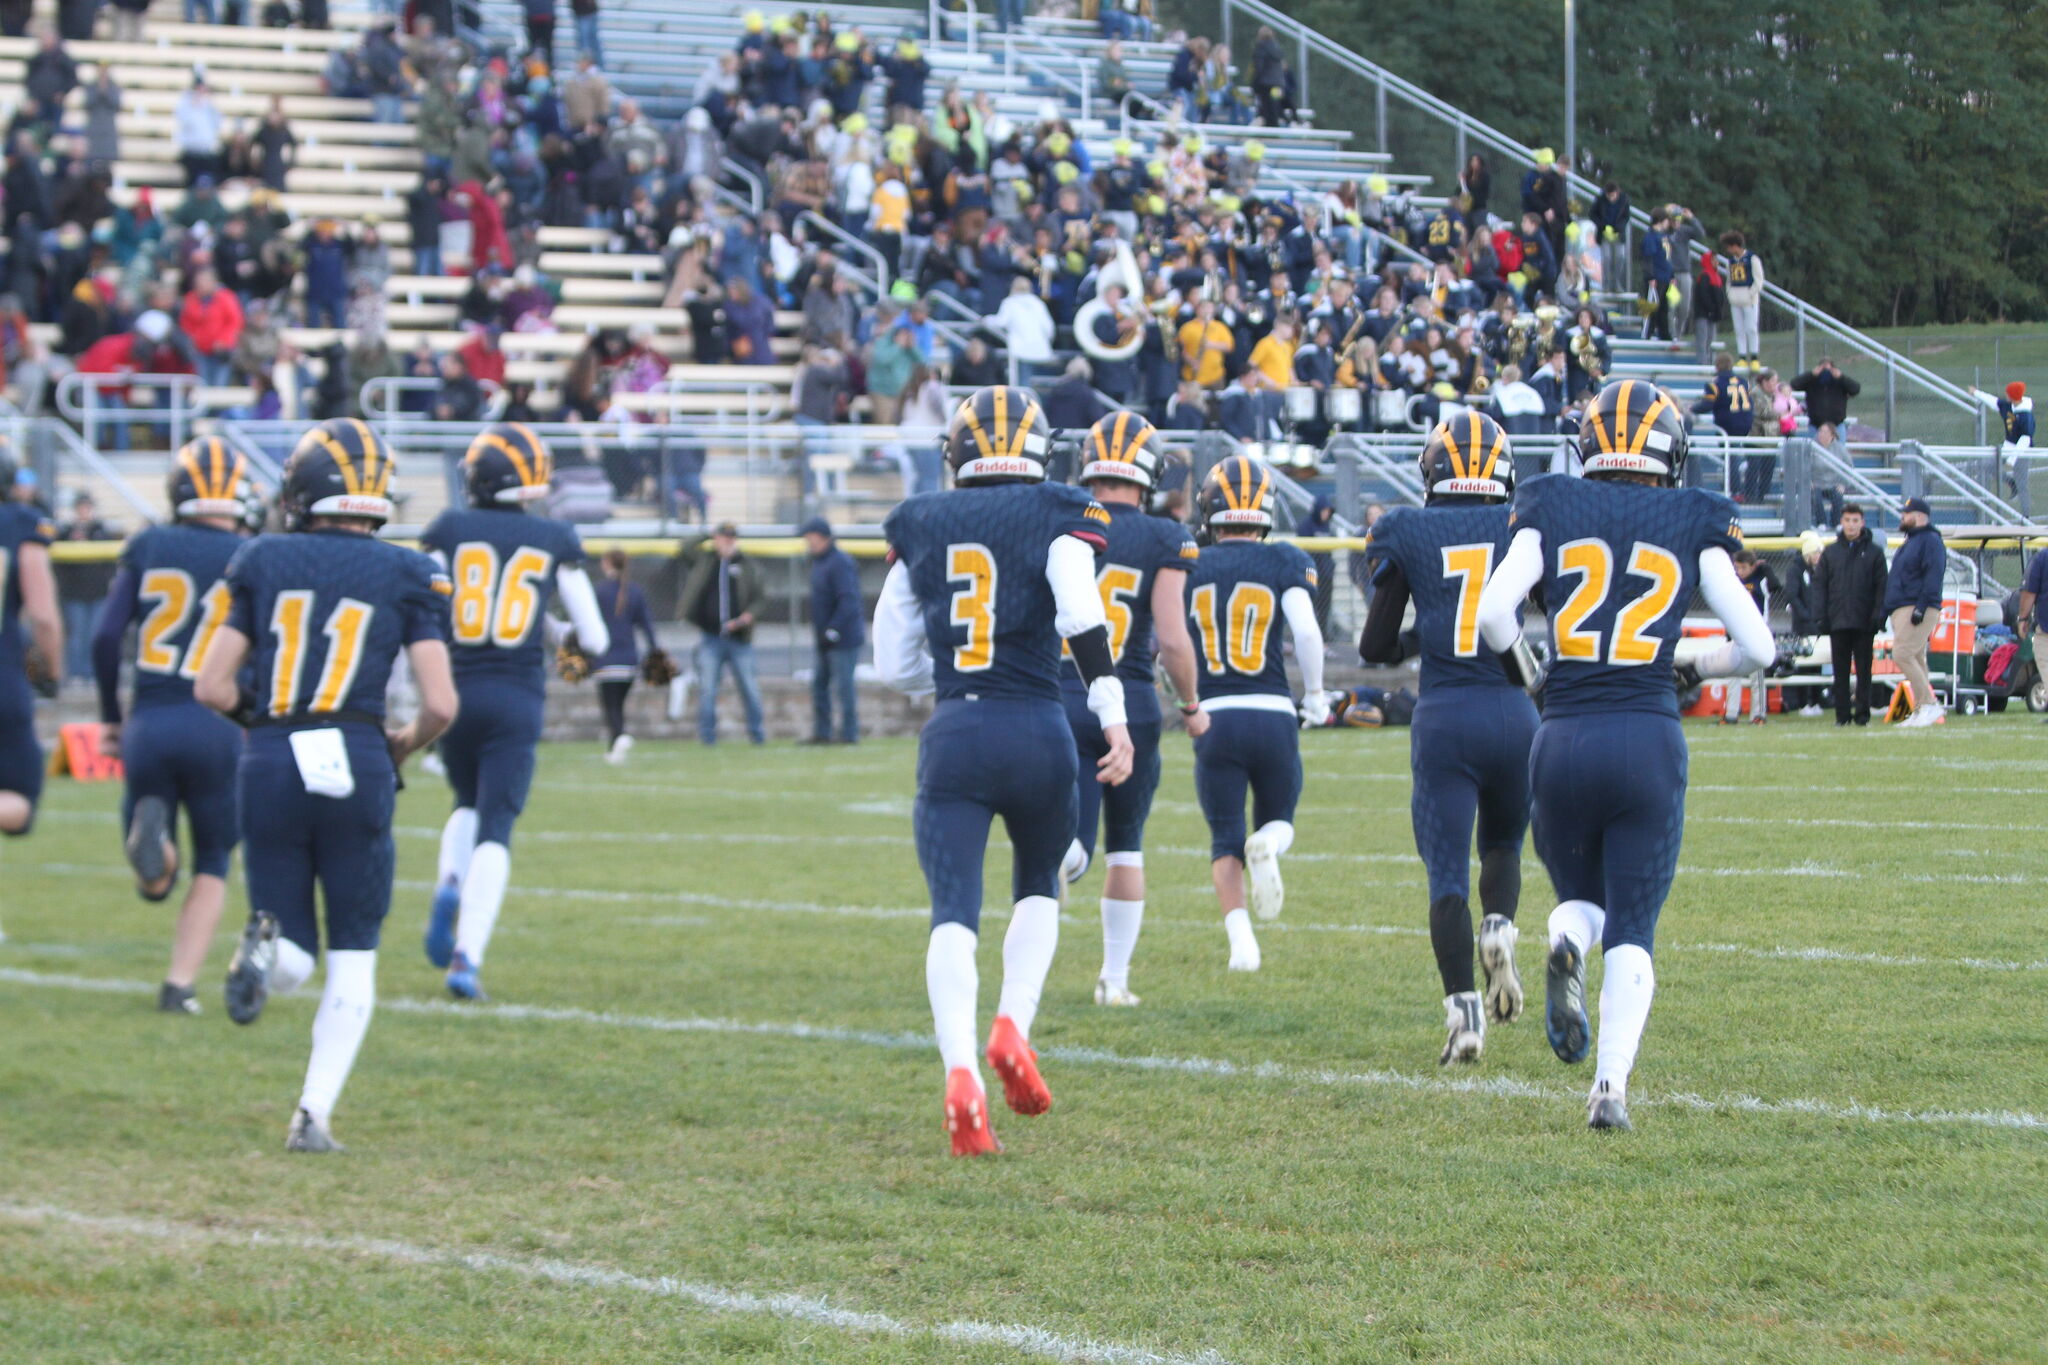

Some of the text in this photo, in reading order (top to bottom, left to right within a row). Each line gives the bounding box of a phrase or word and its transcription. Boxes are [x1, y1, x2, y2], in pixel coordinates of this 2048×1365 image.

[1727, 384, 1751, 412] 71
[974, 461, 1028, 473] Riddell
[1093, 463, 1137, 478] Riddell
[1449, 481, 1496, 493] Riddell
[136, 567, 234, 680] 21
[452, 541, 552, 649] 86
[946, 543, 998, 673] 3
[1060, 563, 1143, 666] 5
[1191, 581, 1275, 676] 10
[1441, 542, 1495, 658] 7
[1554, 537, 1682, 666] 22
[268, 590, 373, 717] 11
